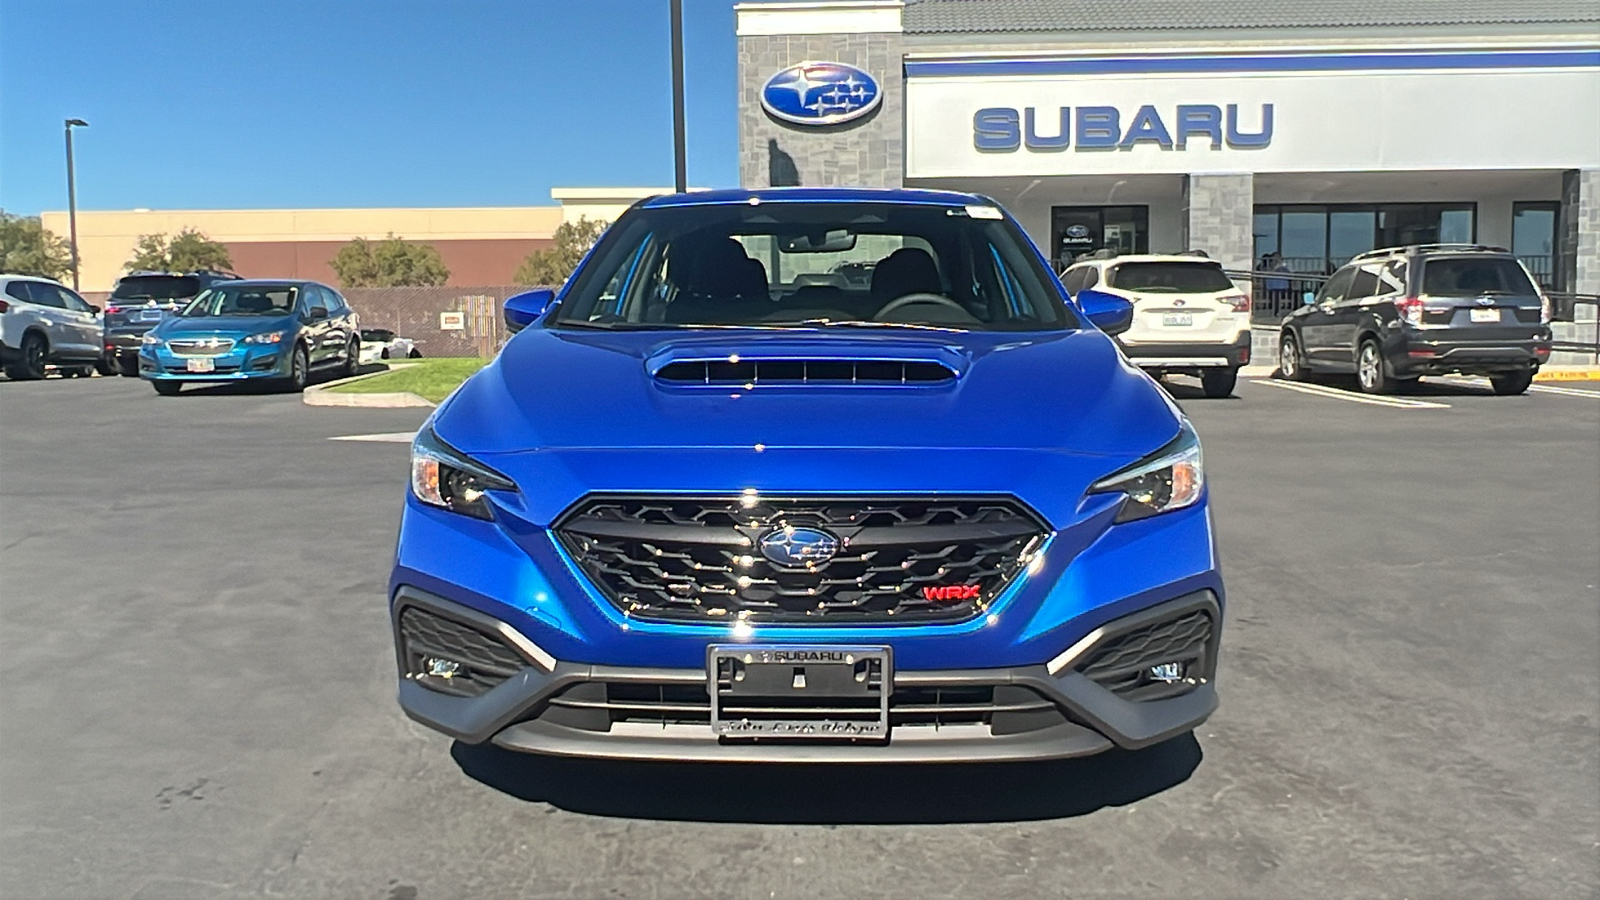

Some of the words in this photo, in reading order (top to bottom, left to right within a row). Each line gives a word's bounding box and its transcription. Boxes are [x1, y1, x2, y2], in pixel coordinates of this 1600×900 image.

[972, 104, 1274, 153] SUBARU
[923, 584, 981, 601] WRX
[775, 651, 843, 661] SUBARU
